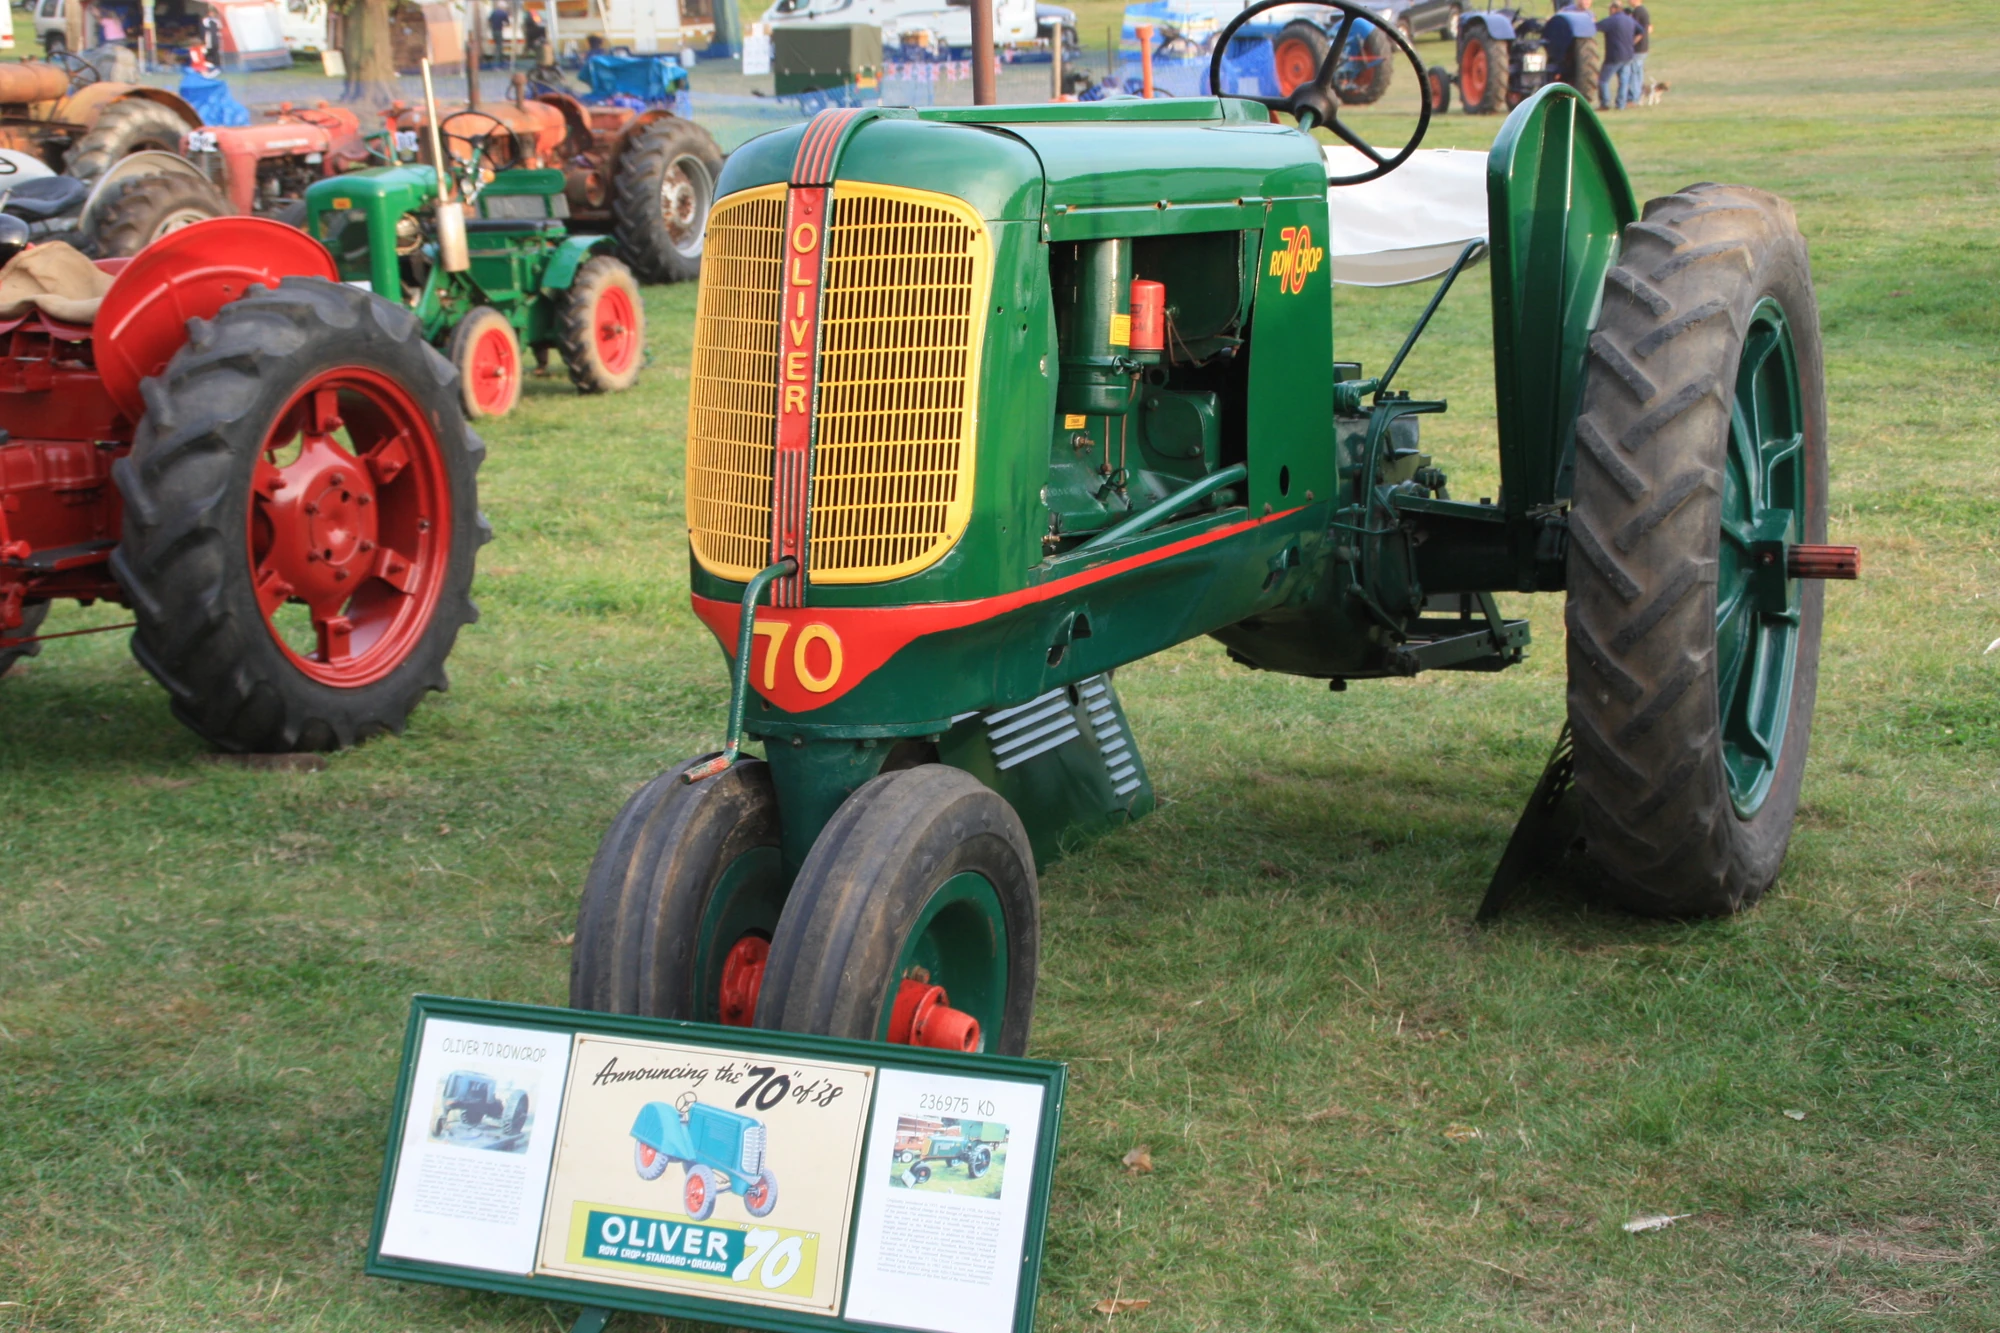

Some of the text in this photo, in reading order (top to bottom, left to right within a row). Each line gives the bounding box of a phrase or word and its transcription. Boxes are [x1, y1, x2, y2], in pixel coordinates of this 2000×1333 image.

[1281, 225, 1311, 294] 70
[785, 222, 818, 414] OLIVER
[753, 621, 843, 693] 70
[442, 1037, 547, 1062] OLIVER 70 ROWCROP
[592, 1056, 709, 1088] Announcing
[715, 1063, 743, 1084] the
[792, 1080, 820, 1104] of
[920, 1093, 995, 1116] 236975 KD
[598, 1244, 619, 1257] ROW
[601, 1216, 729, 1261] OLIVER
